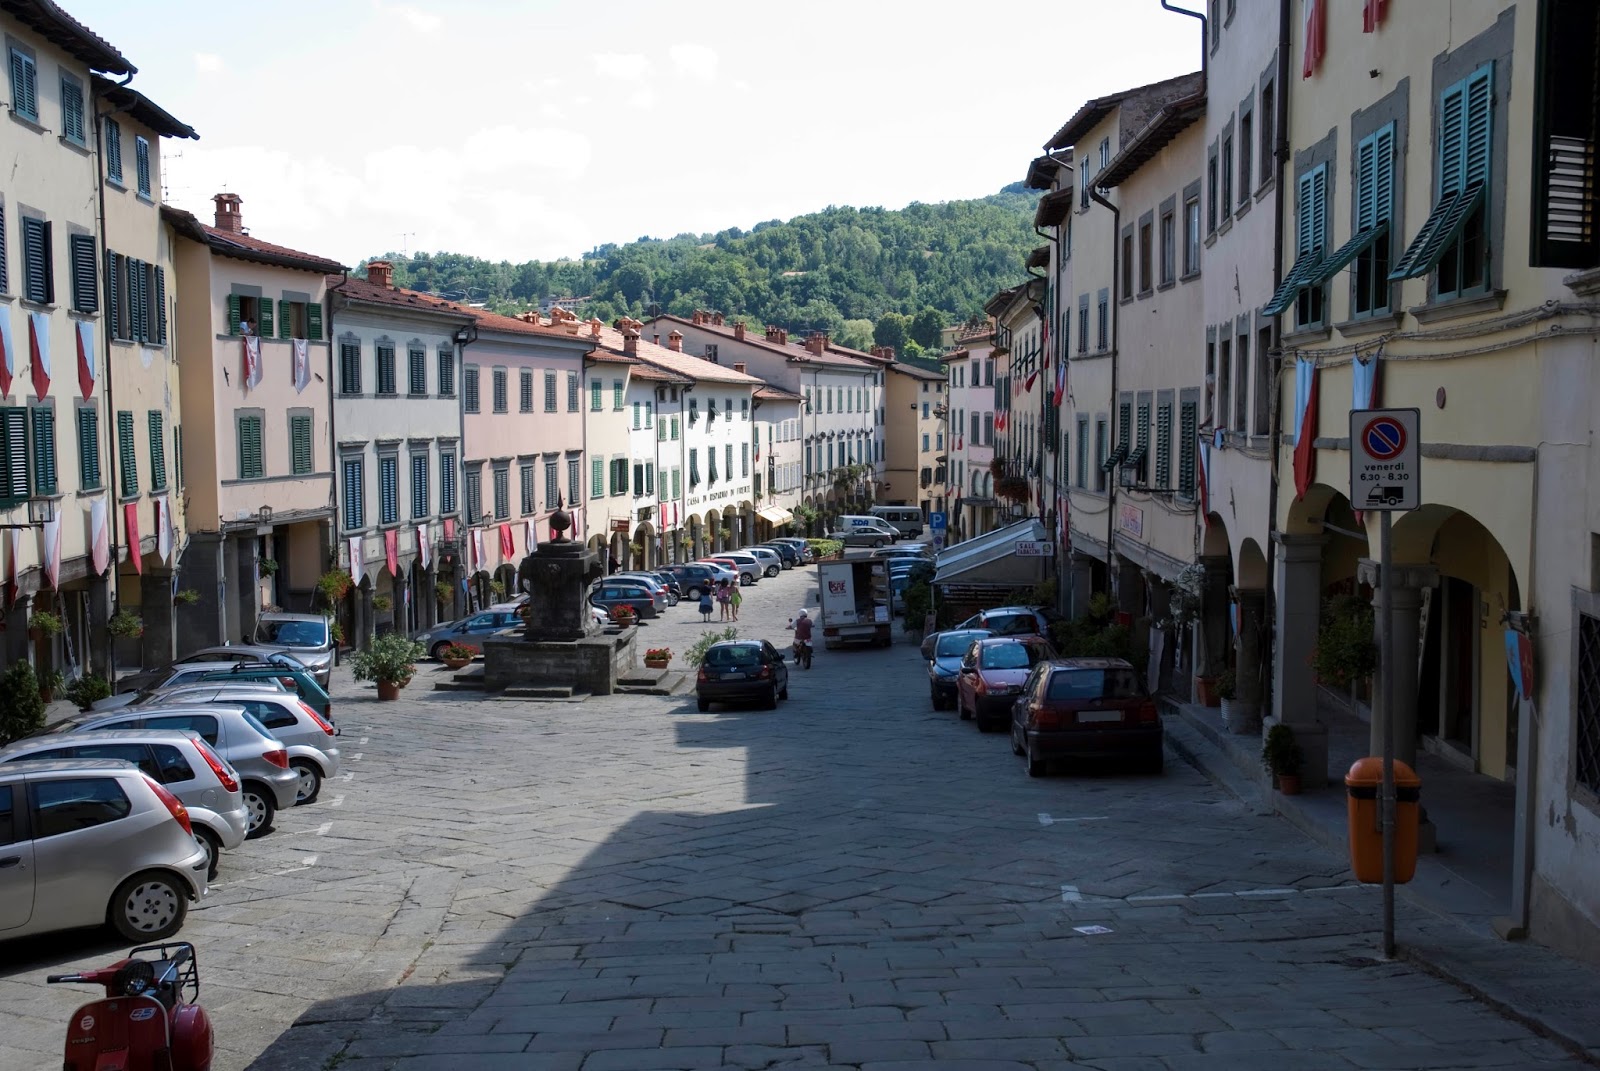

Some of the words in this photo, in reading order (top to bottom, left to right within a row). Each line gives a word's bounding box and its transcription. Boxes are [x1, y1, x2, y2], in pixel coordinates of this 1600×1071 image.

[1364, 462, 1405, 471] venerdi
[687, 496, 700, 506] CASSA
[932, 513, 943, 528] P
